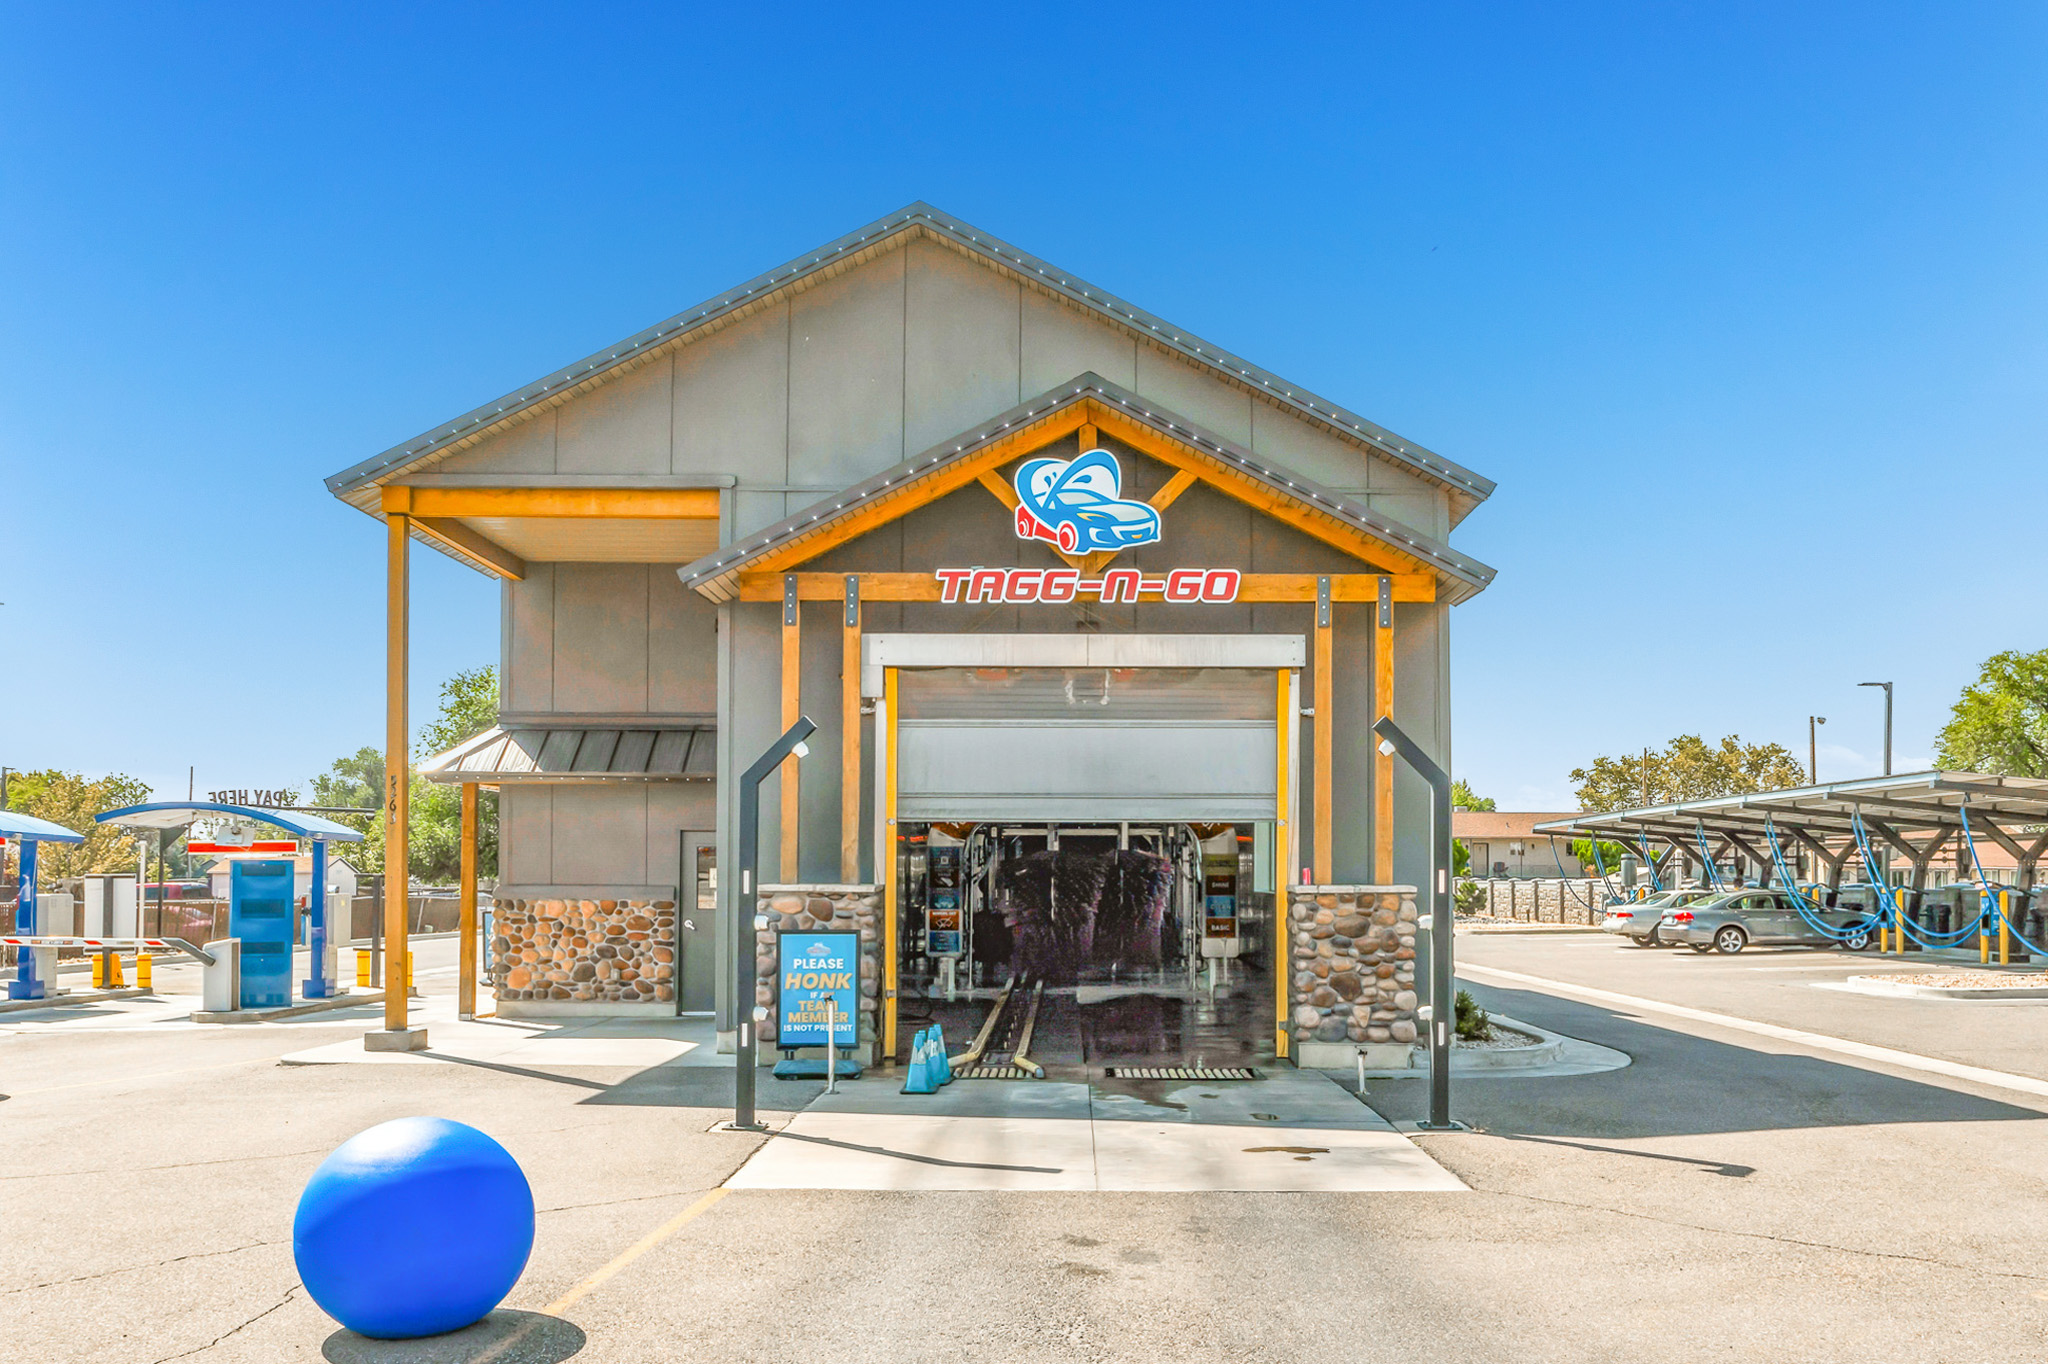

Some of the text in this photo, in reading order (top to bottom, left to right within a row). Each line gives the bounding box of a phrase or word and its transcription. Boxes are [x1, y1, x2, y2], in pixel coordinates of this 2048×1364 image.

[936, 569, 1240, 603] TAGG-N-GO
[793, 958, 844, 969] PLEASE
[785, 973, 852, 989] HONK
[798, 1001, 838, 1011] TEAM
